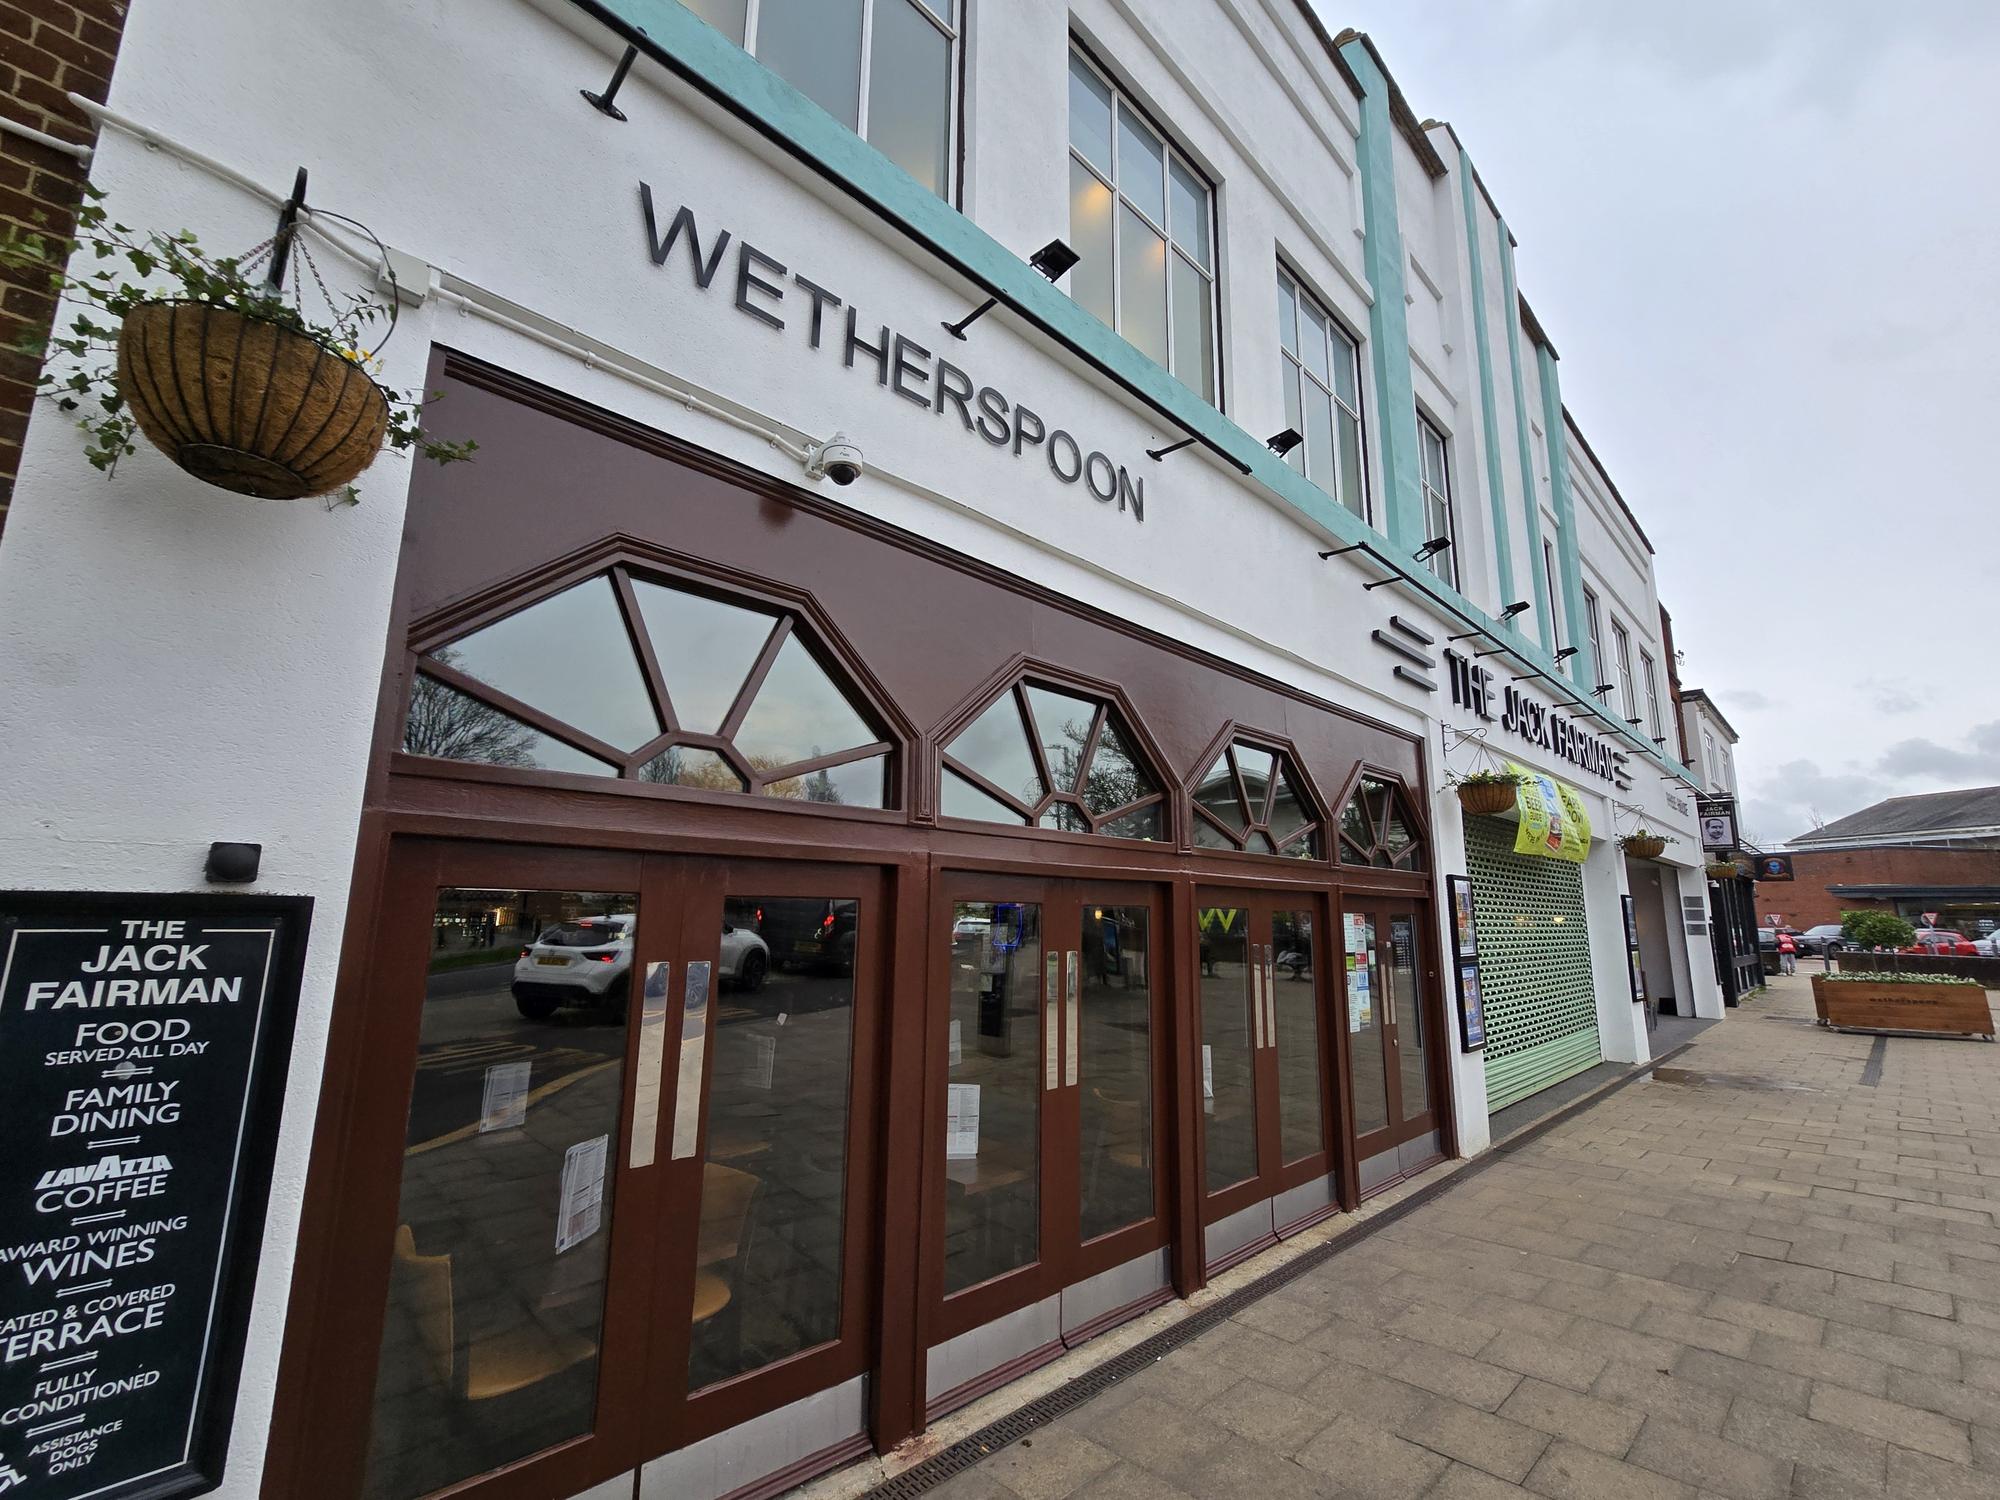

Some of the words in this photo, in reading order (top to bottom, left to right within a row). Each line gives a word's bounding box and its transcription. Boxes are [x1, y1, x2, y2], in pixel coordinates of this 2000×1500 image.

[639, 180, 1145, 522] WETHERSPOON
[1443, 648, 1498, 722] THE
[1502, 686, 1551, 750] JACK
[1550, 714, 1614, 781] FAIRMAN
[121, 920, 186, 939] THE
[81, 944, 211, 973] JACK
[24, 976, 243, 1011] FAIRMAN
[74, 1018, 191, 1047] FOOD
[44, 1048, 125, 1066] SERVED
[125, 1045, 164, 1060] ALL
[169, 1041, 210, 1057] DAY
[64, 1080, 180, 1112] FAMILY
[50, 1103, 181, 1137] DINING
[34, 1154, 174, 1190] LAVAZZA
[36, 1174, 168, 1213] COFFEE
[0, 1235, 80, 1262] AWARD
[87, 1215, 188, 1246] WINNING
[22, 1237, 156, 1285] WINES
[0, 1309, 59, 1335] ATED
[63, 1304, 79, 1320] &
[84, 1283, 176, 1314] COVERED
[0, 1370, 160, 1425] CONDITIONED
[33, 1368, 97, 1399] FULLY
[28, 1419, 123, 1457] ASSISTANCE
[50, 1439, 98, 1463] DOGS
[48, 1452, 96, 1475] ONLY
